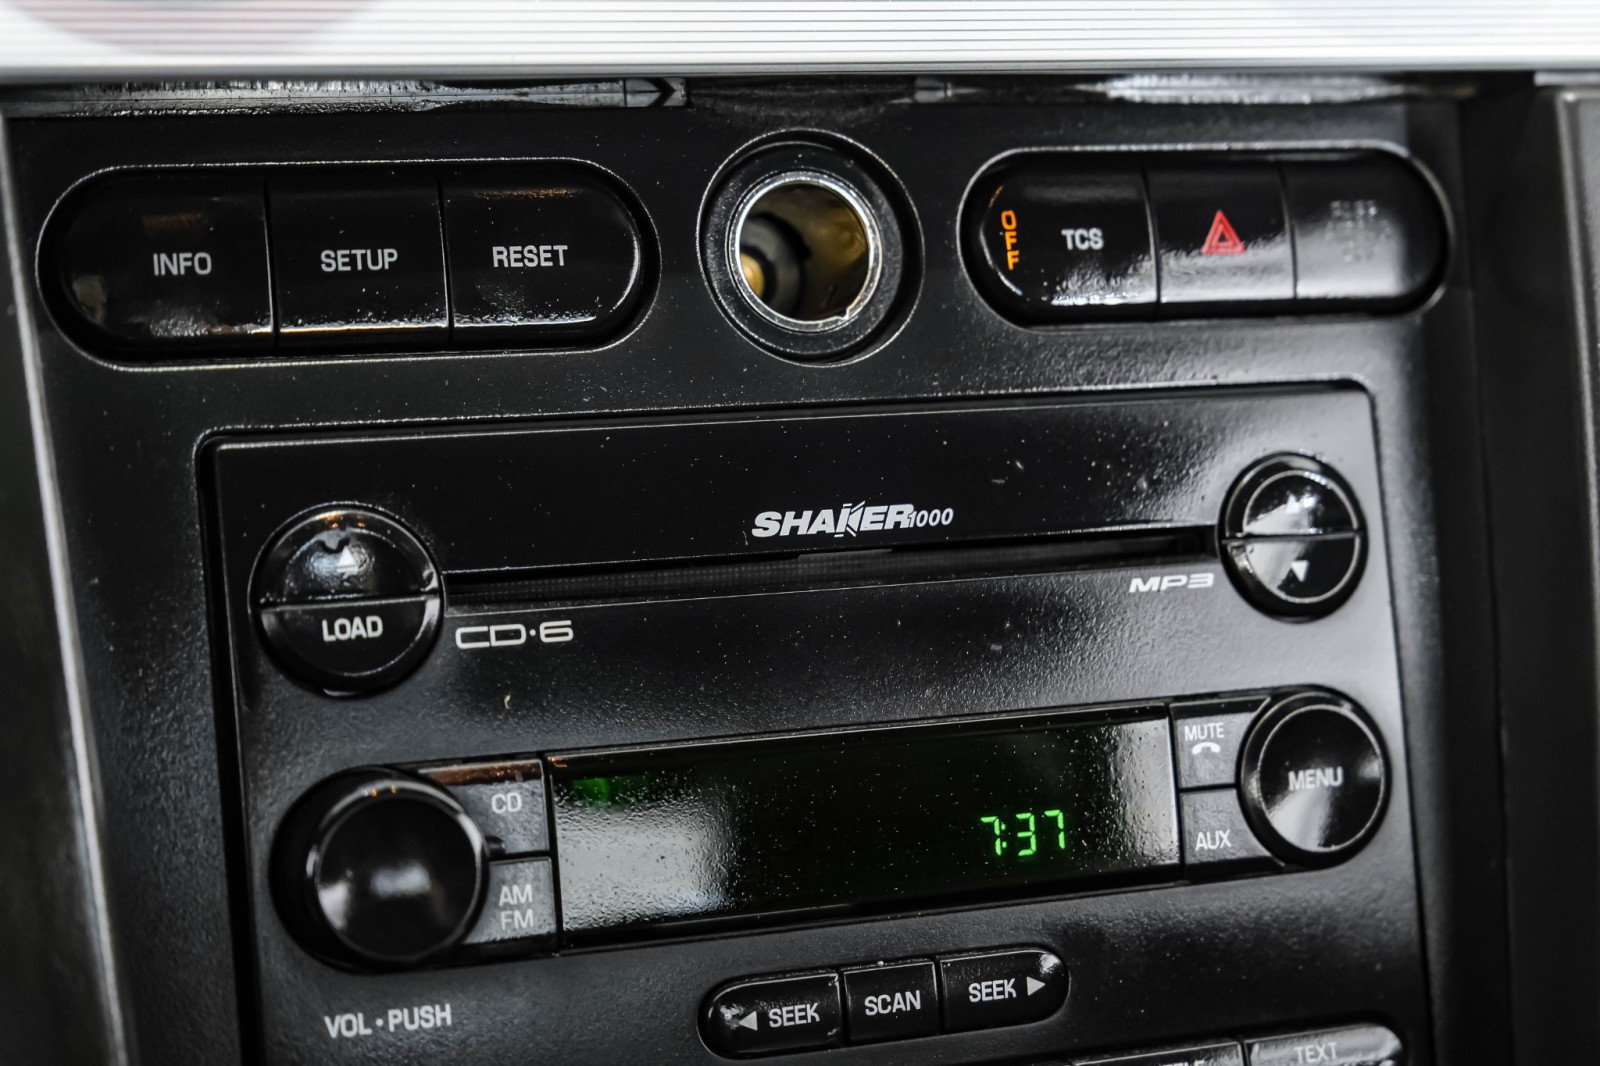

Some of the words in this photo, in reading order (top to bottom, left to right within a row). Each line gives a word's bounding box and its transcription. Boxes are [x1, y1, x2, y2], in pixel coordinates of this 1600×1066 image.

[1001, 209, 1020, 271] OFF
[1061, 228, 1104, 251] TCS
[152, 251, 212, 277] INFO
[320, 248, 398, 274] SETUP
[492, 244, 568, 269] RESET
[1129, 572, 1215, 593] MP3
[321, 615, 383, 642] LOAD
[1184, 722, 1225, 742] MUTE
[1288, 767, 1344, 791] MENU
[491, 792, 522, 814] CD
[981, 809, 1066, 858] 7:37
[1195, 830, 1232, 851] AUX
[499, 884, 533, 907] AM
[501, 908, 534, 931] FM
[968, 978, 1018, 1003] SEEK
[768, 1003, 821, 1028] SEEK
[864, 990, 922, 1017] SCAN
[1294, 1042, 1337, 1064] TEXT
